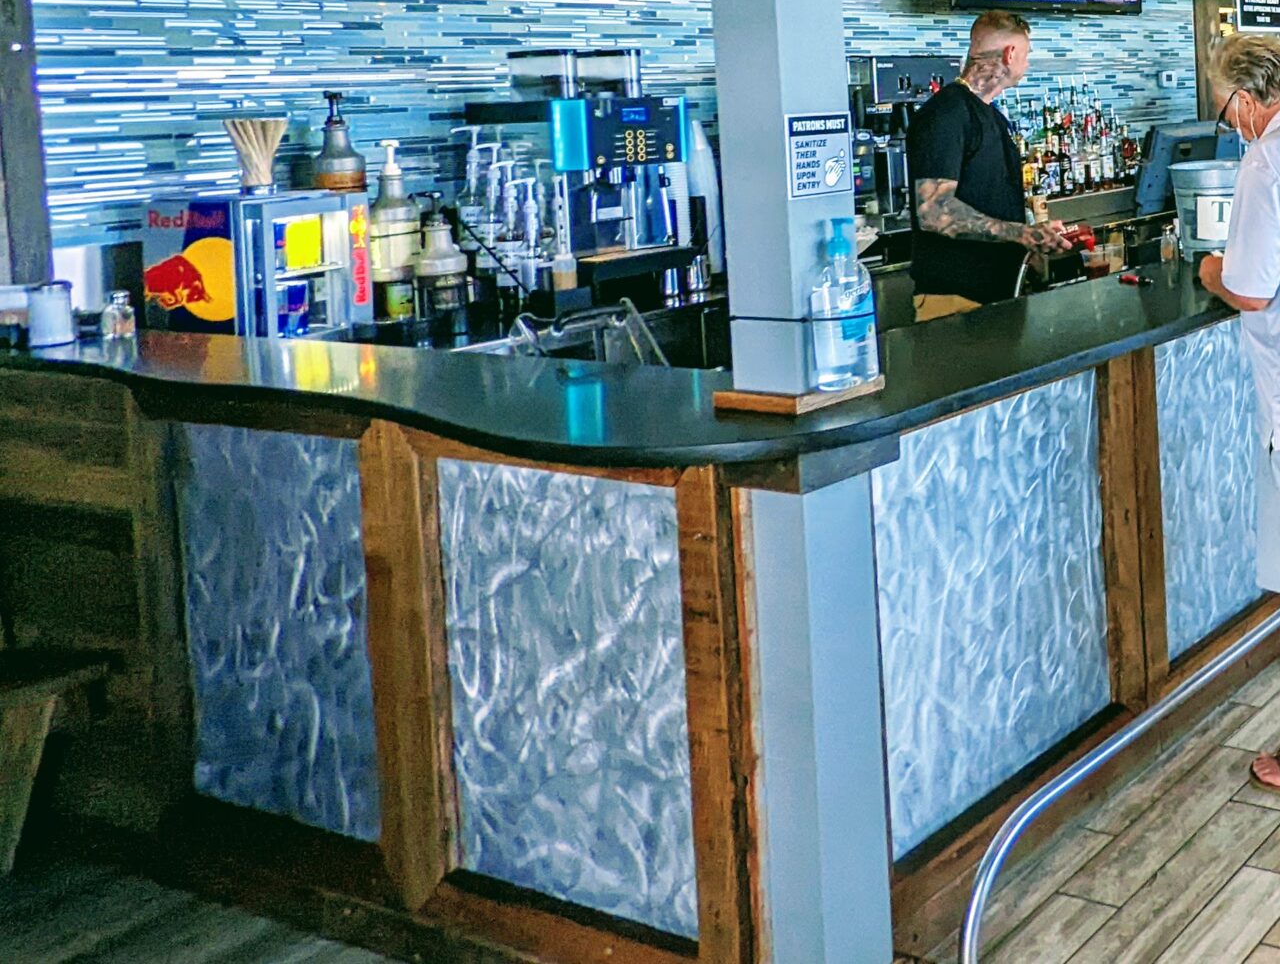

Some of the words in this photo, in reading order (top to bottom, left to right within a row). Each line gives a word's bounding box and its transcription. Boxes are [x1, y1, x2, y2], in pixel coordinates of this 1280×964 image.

[792, 119, 826, 132] PATRONS
[825, 118, 846, 130] MUST
[795, 139, 827, 149] SANITIZE
[796, 150, 817, 159] THEIR
[796, 160, 821, 170] HANDS
[796, 171, 816, 180] UPON
[797, 181, 821, 191] ENTRY
[148, 210, 184, 228] Red
[353, 249, 367, 276] Bull
[353, 276, 367, 303] Red
